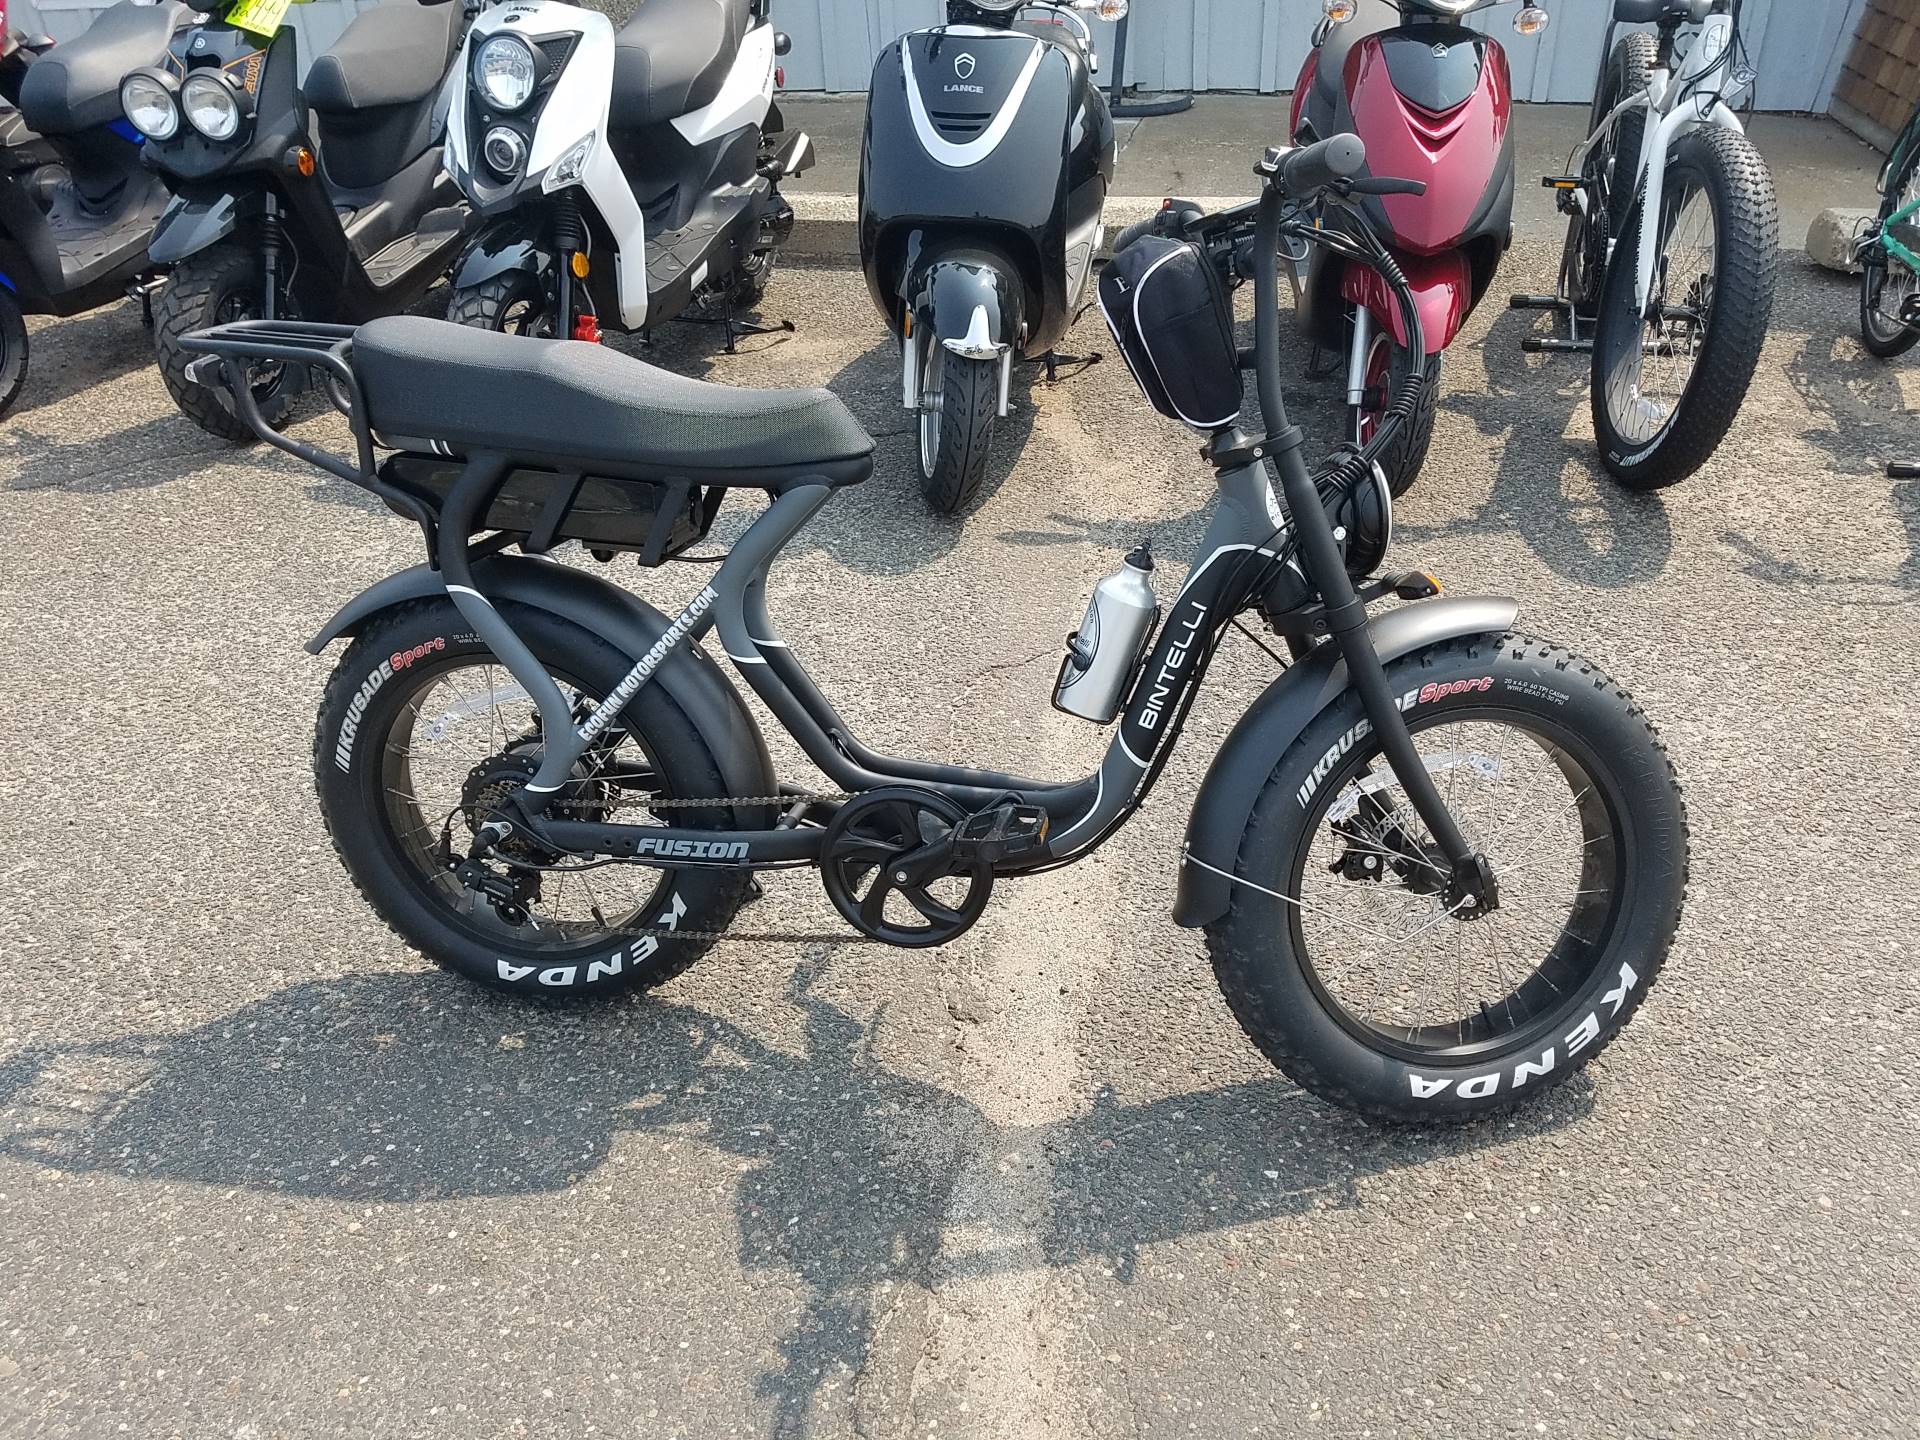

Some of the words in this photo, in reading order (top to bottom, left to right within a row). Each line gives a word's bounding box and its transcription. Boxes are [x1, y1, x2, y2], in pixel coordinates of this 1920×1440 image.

[507, 6, 540, 14] LANCE
[244, 56, 262, 95] ZUMA
[943, 84, 985, 94] LANCE
[577, 692, 624, 742] ECOFUN
[616, 584, 720, 699] MOTORSPORTS.COM
[1137, 600, 1208, 730] BINTELLI
[338, 658, 395, 749] KRUSADE
[389, 636, 446, 671] Sport
[1418, 675, 1495, 703] Sport
[1506, 684, 1523, 693] WIRE
[1523, 687, 1541, 697] BEAD
[1554, 697, 1565, 706] PSI
[1538, 685, 1549, 694] TPI
[1548, 688, 1570, 701] CASING
[636, 837, 750, 859] FUSION
[496, 890, 688, 986] KENDA
[1408, 960, 1638, 1099] KENDA
